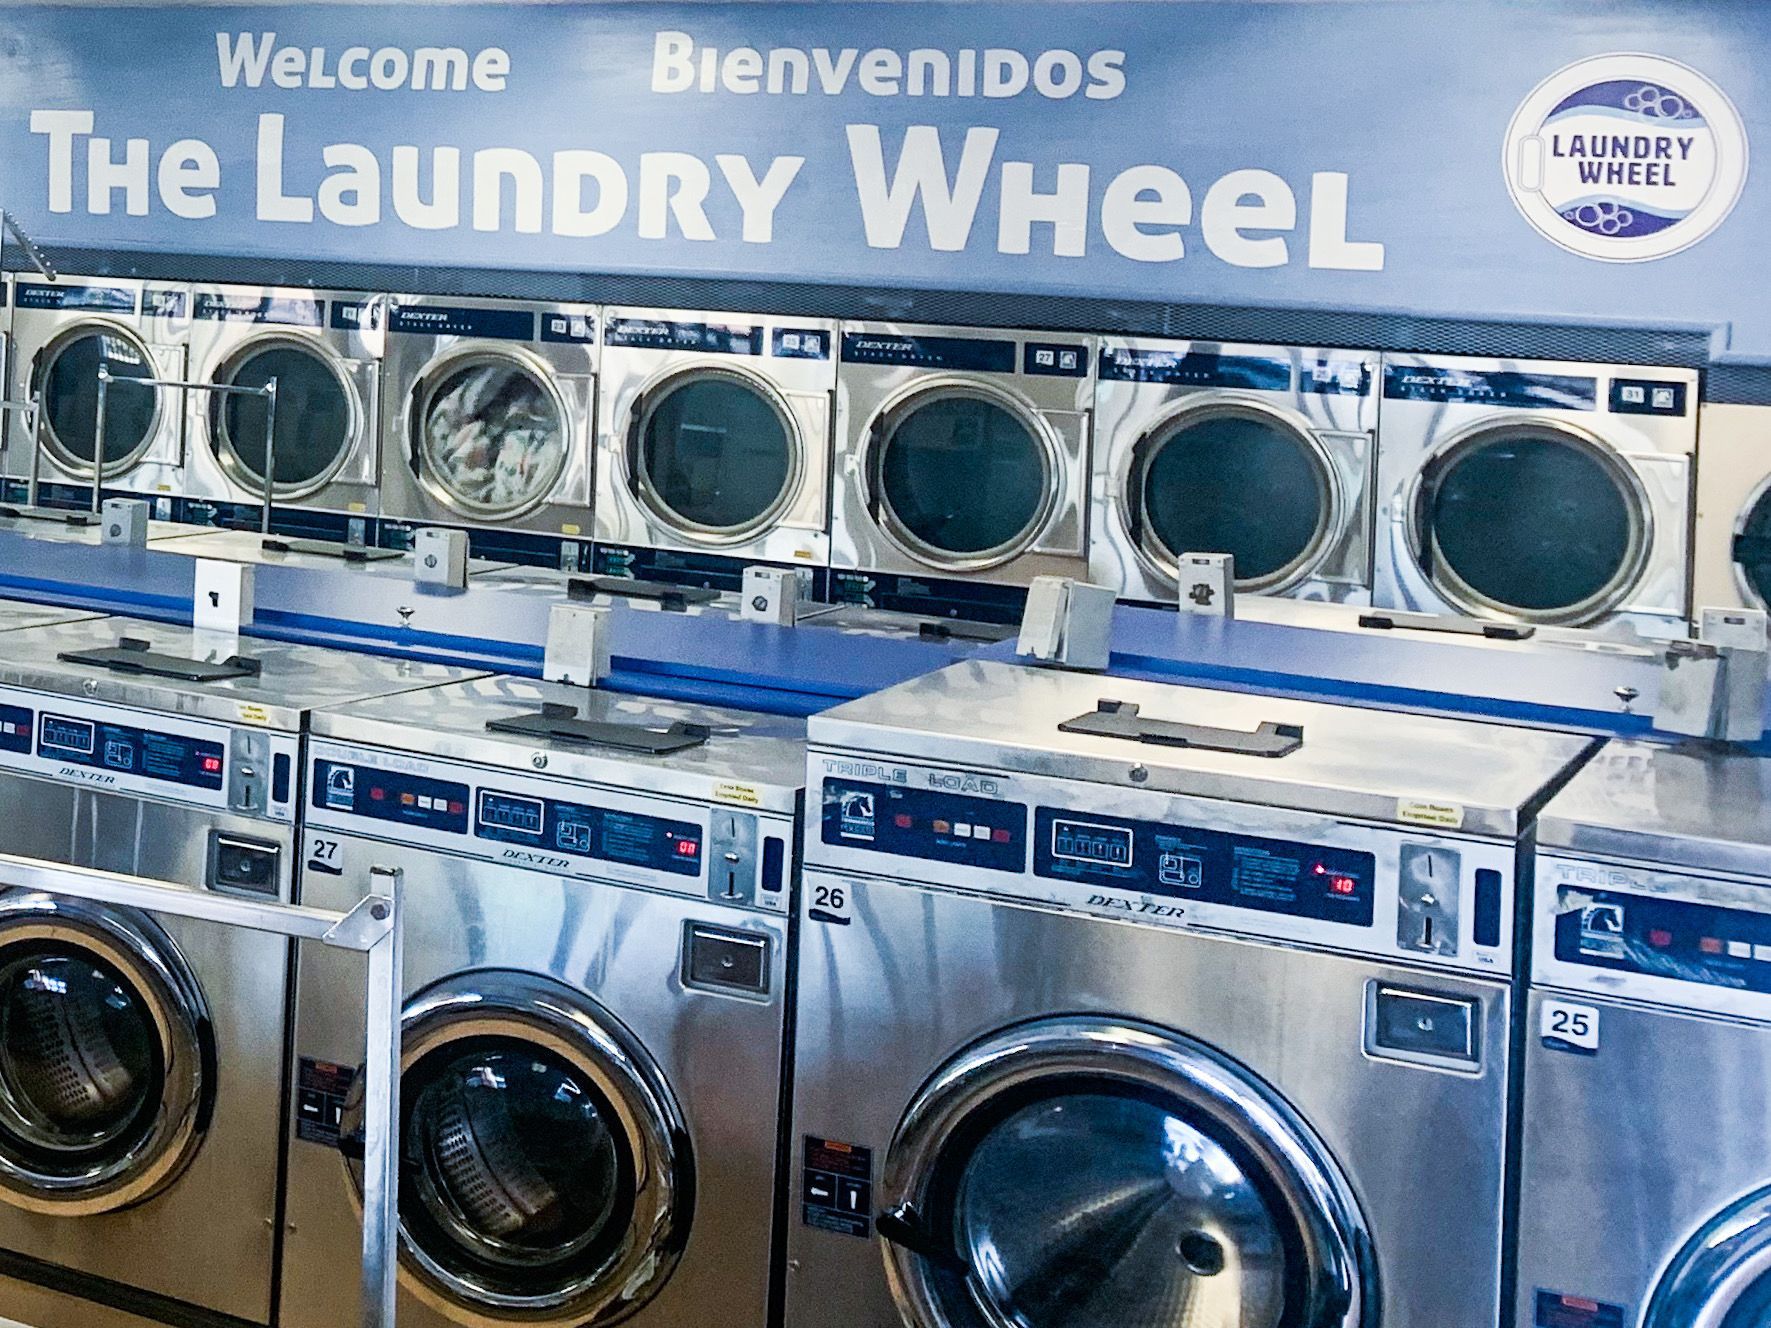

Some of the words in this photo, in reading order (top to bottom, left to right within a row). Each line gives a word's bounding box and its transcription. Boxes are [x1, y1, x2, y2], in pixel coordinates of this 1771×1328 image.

[1552, 134, 1694, 161] LAUNDRY
[1578, 161, 1676, 187] WHEEL
[401, 311, 448, 321] DEXTER
[856, 341, 913, 351] DEXTER
[60, 767, 116, 784] DEXTER
[822, 759, 908, 784] TRIPLE
[928, 772, 998, 795] LOAD
[313, 839, 339, 860] 27
[503, 849, 570, 868] DEXTER
[814, 885, 844, 909] 26
[1086, 894, 1185, 918] DEXTER
[1552, 1009, 1589, 1037] 25
